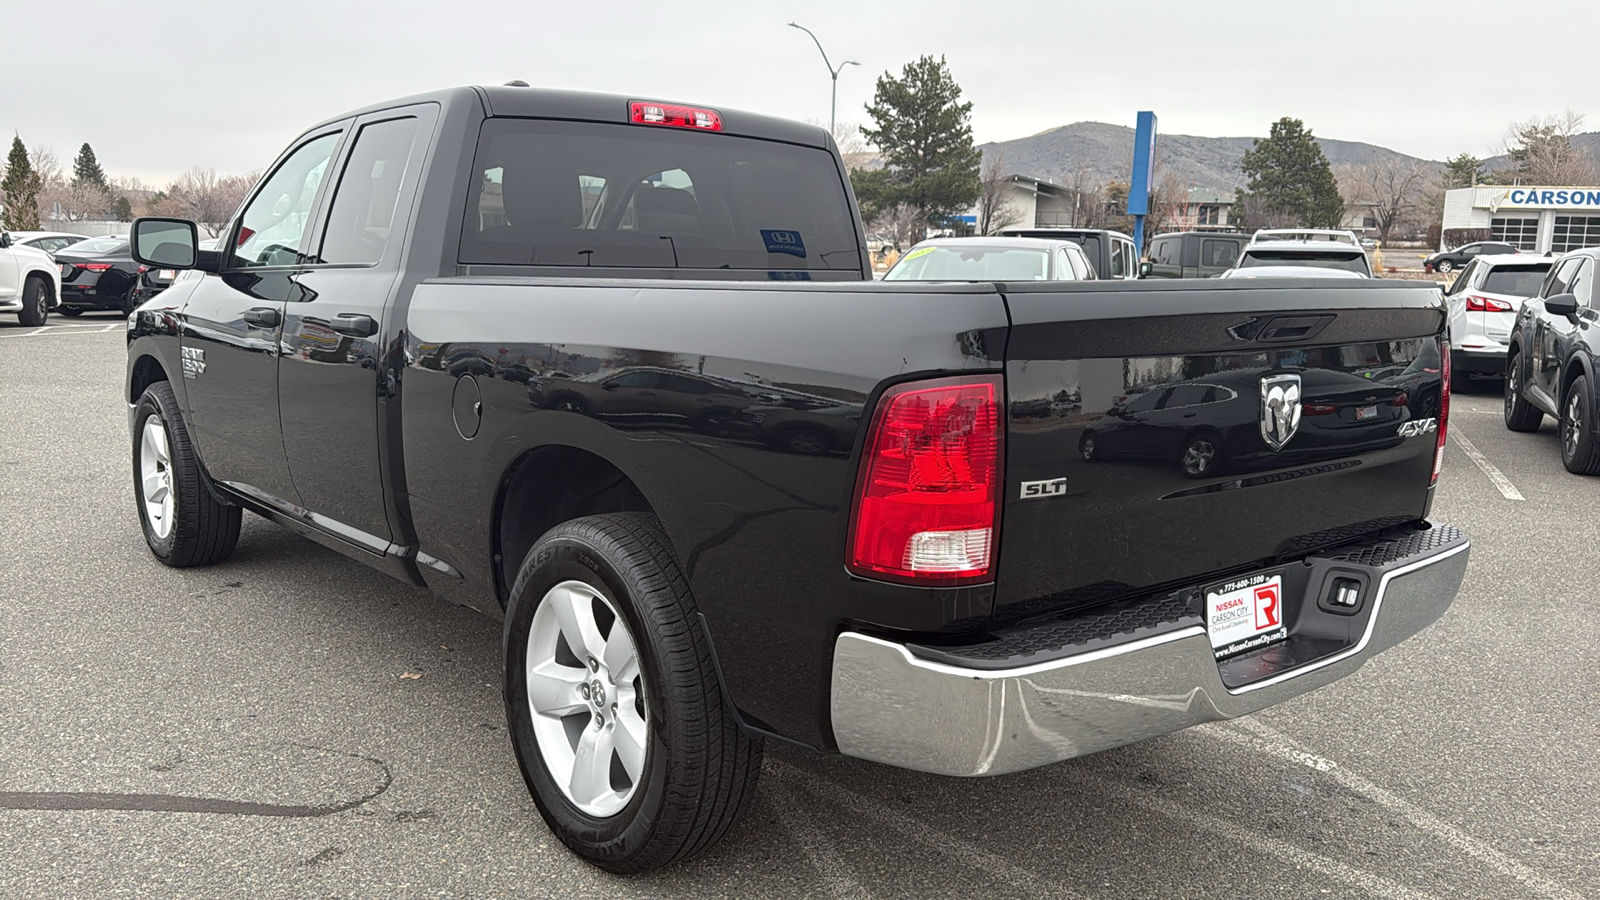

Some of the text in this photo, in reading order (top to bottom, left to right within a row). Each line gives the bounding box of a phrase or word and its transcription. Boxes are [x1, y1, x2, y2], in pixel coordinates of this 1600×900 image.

[1511, 189, 1600, 206] CARSON
[1025, 480, 1065, 496] SLT
[1224, 575, 1265, 592] 775-600-1500
[1215, 598, 1243, 612] NISSAN
[1212, 606, 1249, 624] CARSON CITY
[1215, 633, 1280, 658] www.NissanCarsonCity.com
